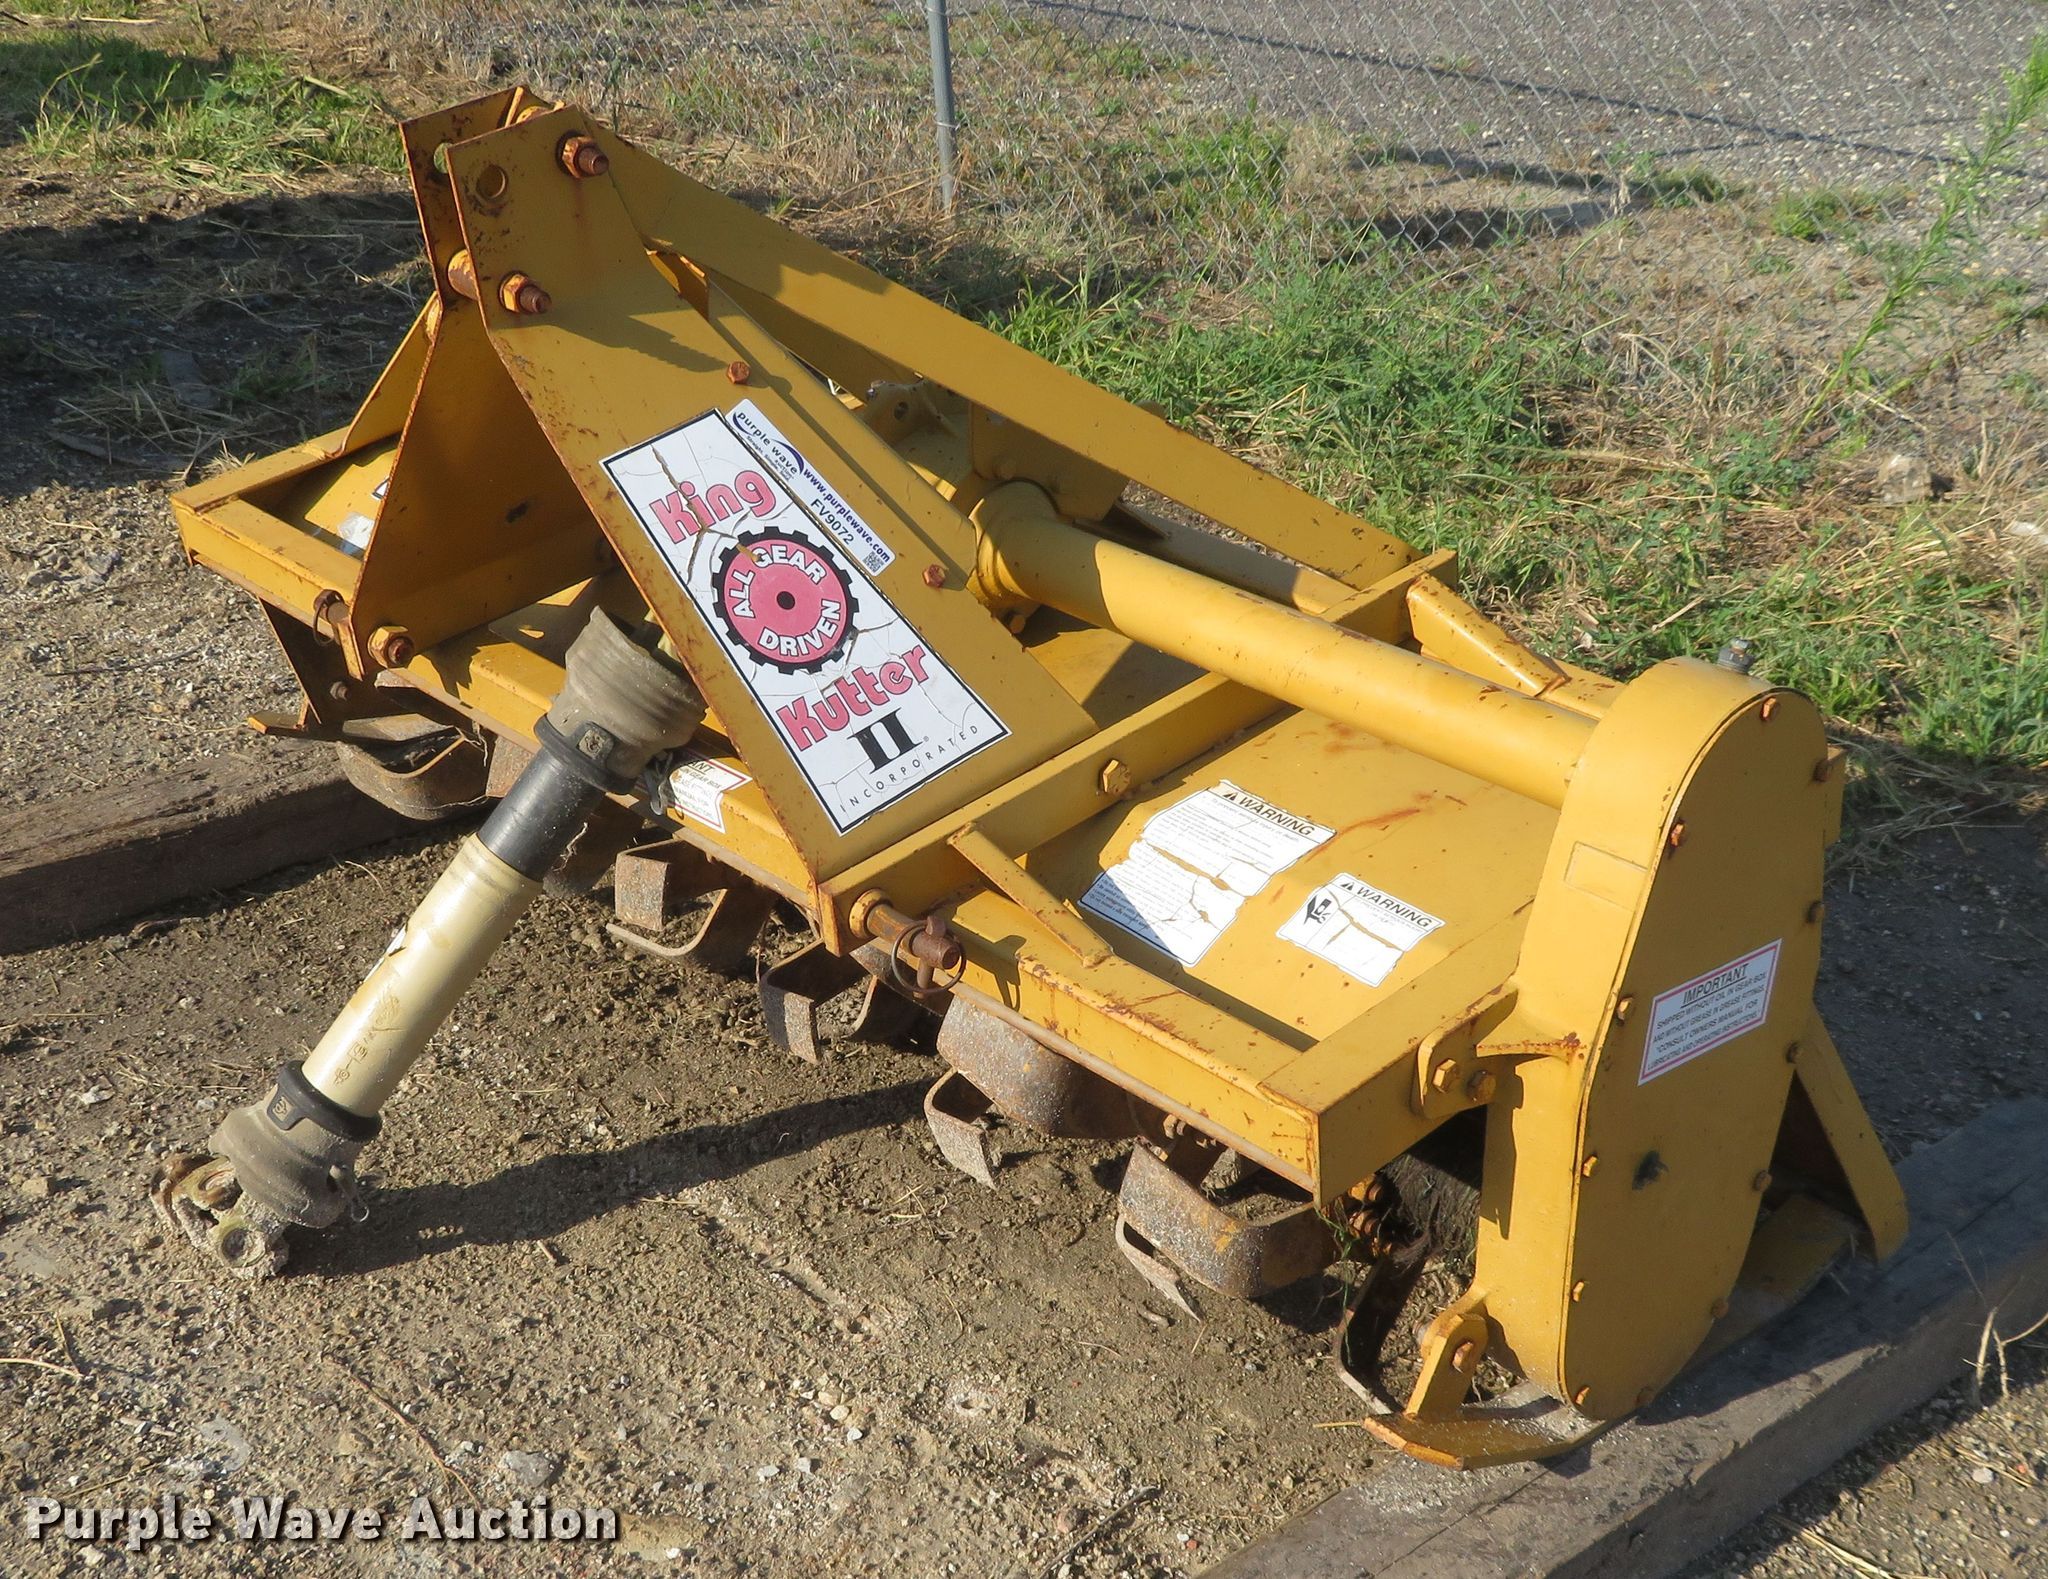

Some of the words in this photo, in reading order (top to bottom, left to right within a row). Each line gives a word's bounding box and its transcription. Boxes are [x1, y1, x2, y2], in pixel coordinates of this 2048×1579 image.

[737, 412, 770, 446] purple
[772, 446, 797, 474] wave
[649, 470, 776, 544] King
[803, 468, 891, 563] www.purplewave.com
[811, 498, 854, 545] FV9072
[729, 569, 756, 619] ALL
[750, 544, 827, 585] GEAR
[758, 599, 841, 657] DRIVEN
[775, 645, 929, 751] Kutter
[840, 725, 978, 812] INCORPORATED
[846, 707, 923, 775] II
[1239, 796, 1315, 836] WARNING
[1357, 887, 1433, 927] WARNING
[1657, 1010, 1685, 1030] SHIPPED
[1686, 996, 1714, 1016] WITHOUT
[1683, 963, 1748, 1004] IMPORTANT
